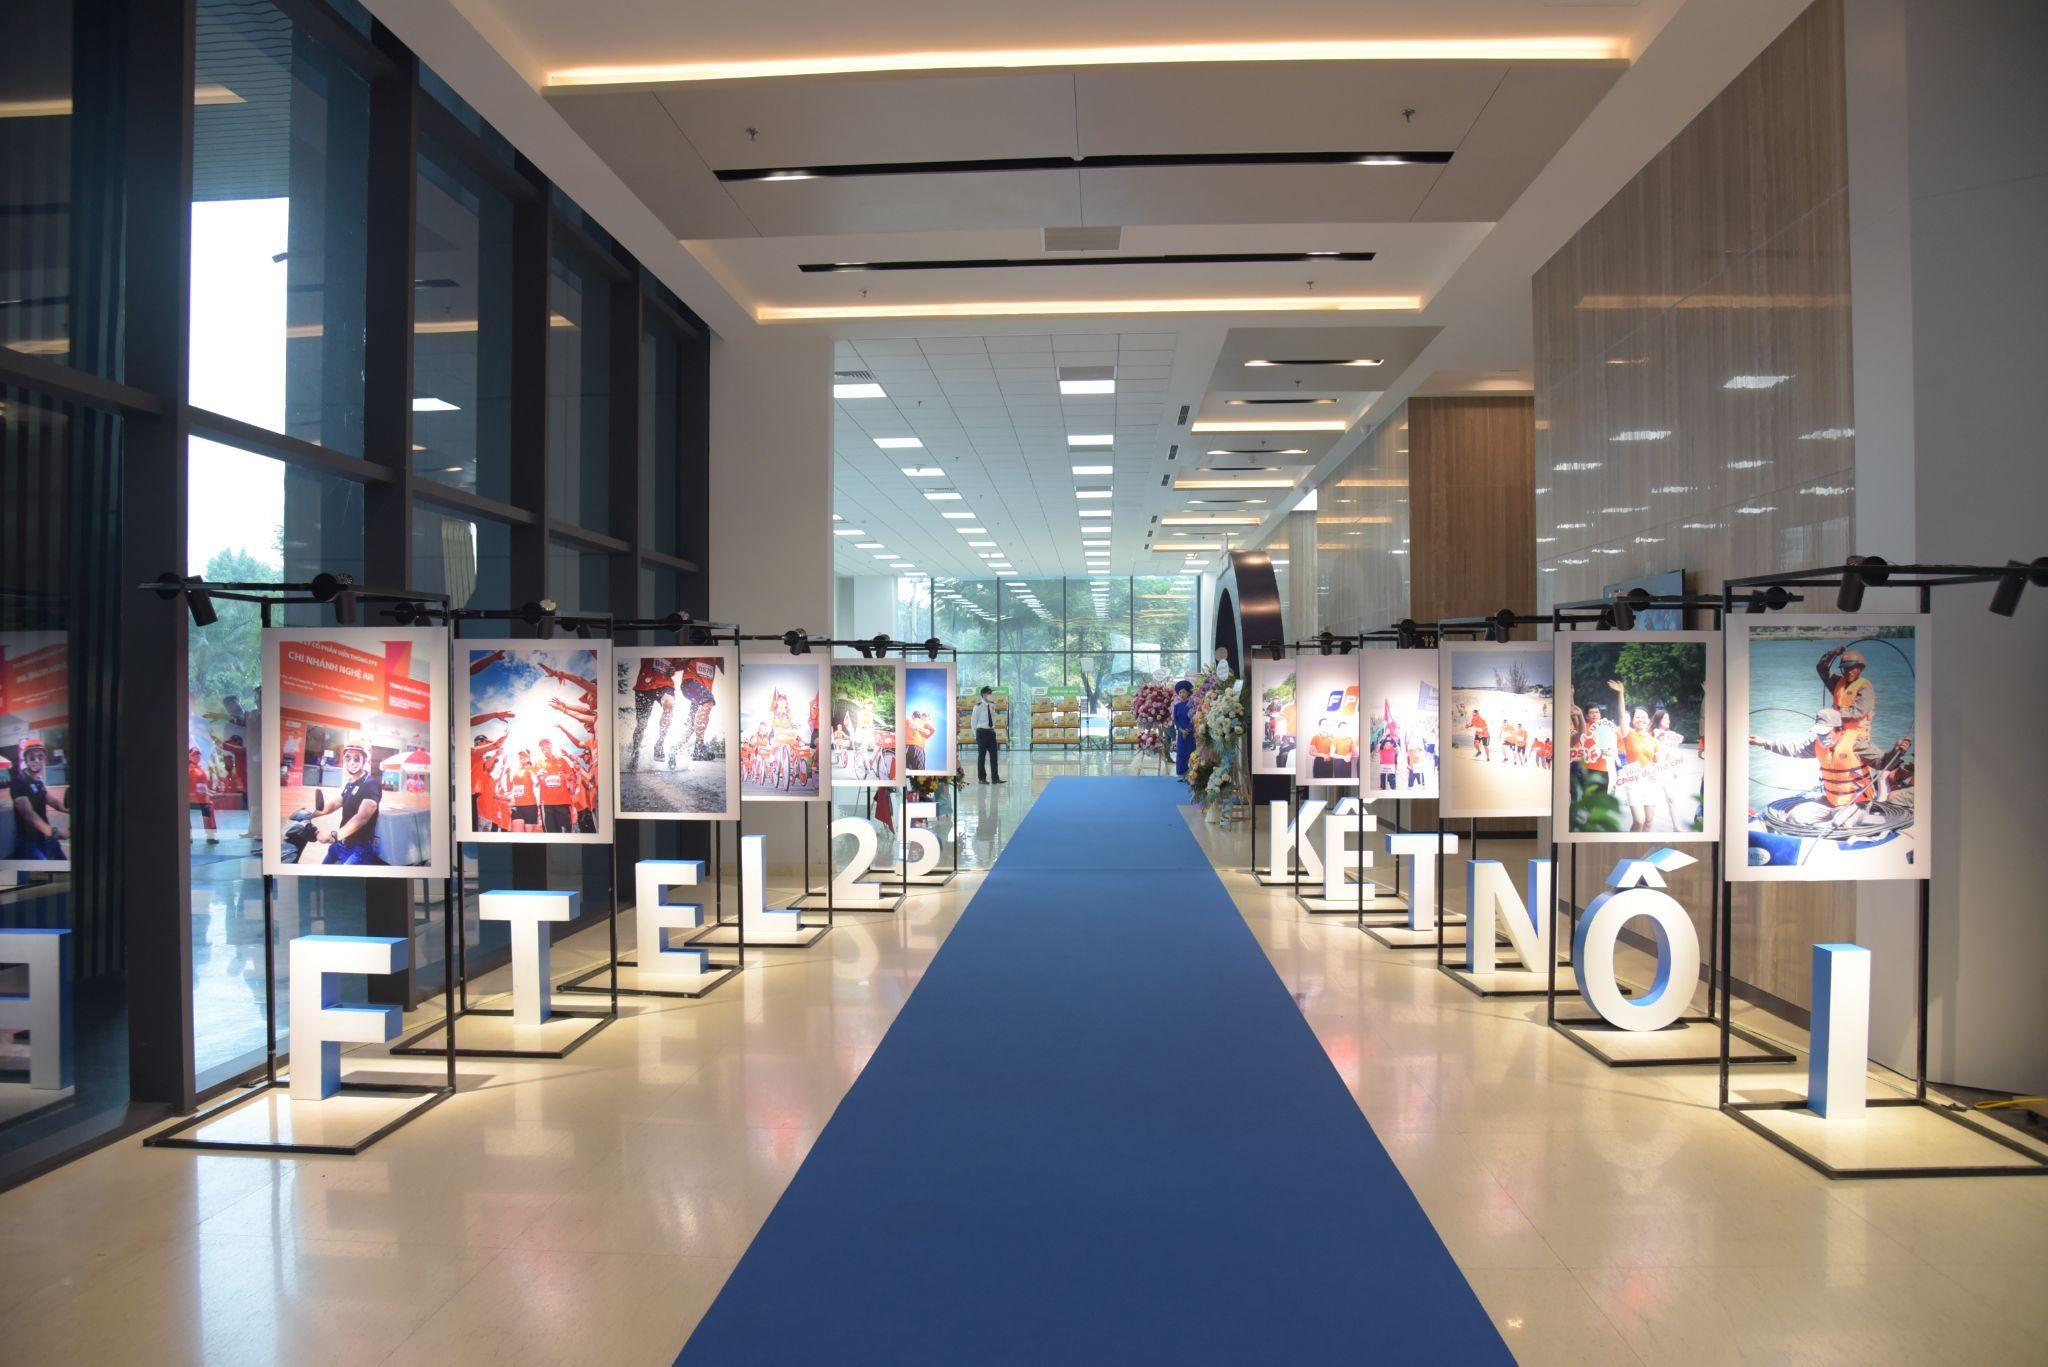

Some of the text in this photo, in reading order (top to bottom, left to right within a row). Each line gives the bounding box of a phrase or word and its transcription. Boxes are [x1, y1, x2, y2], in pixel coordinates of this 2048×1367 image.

[288, 651, 375, 683] CHI NHÁNH NGHỆ AN
